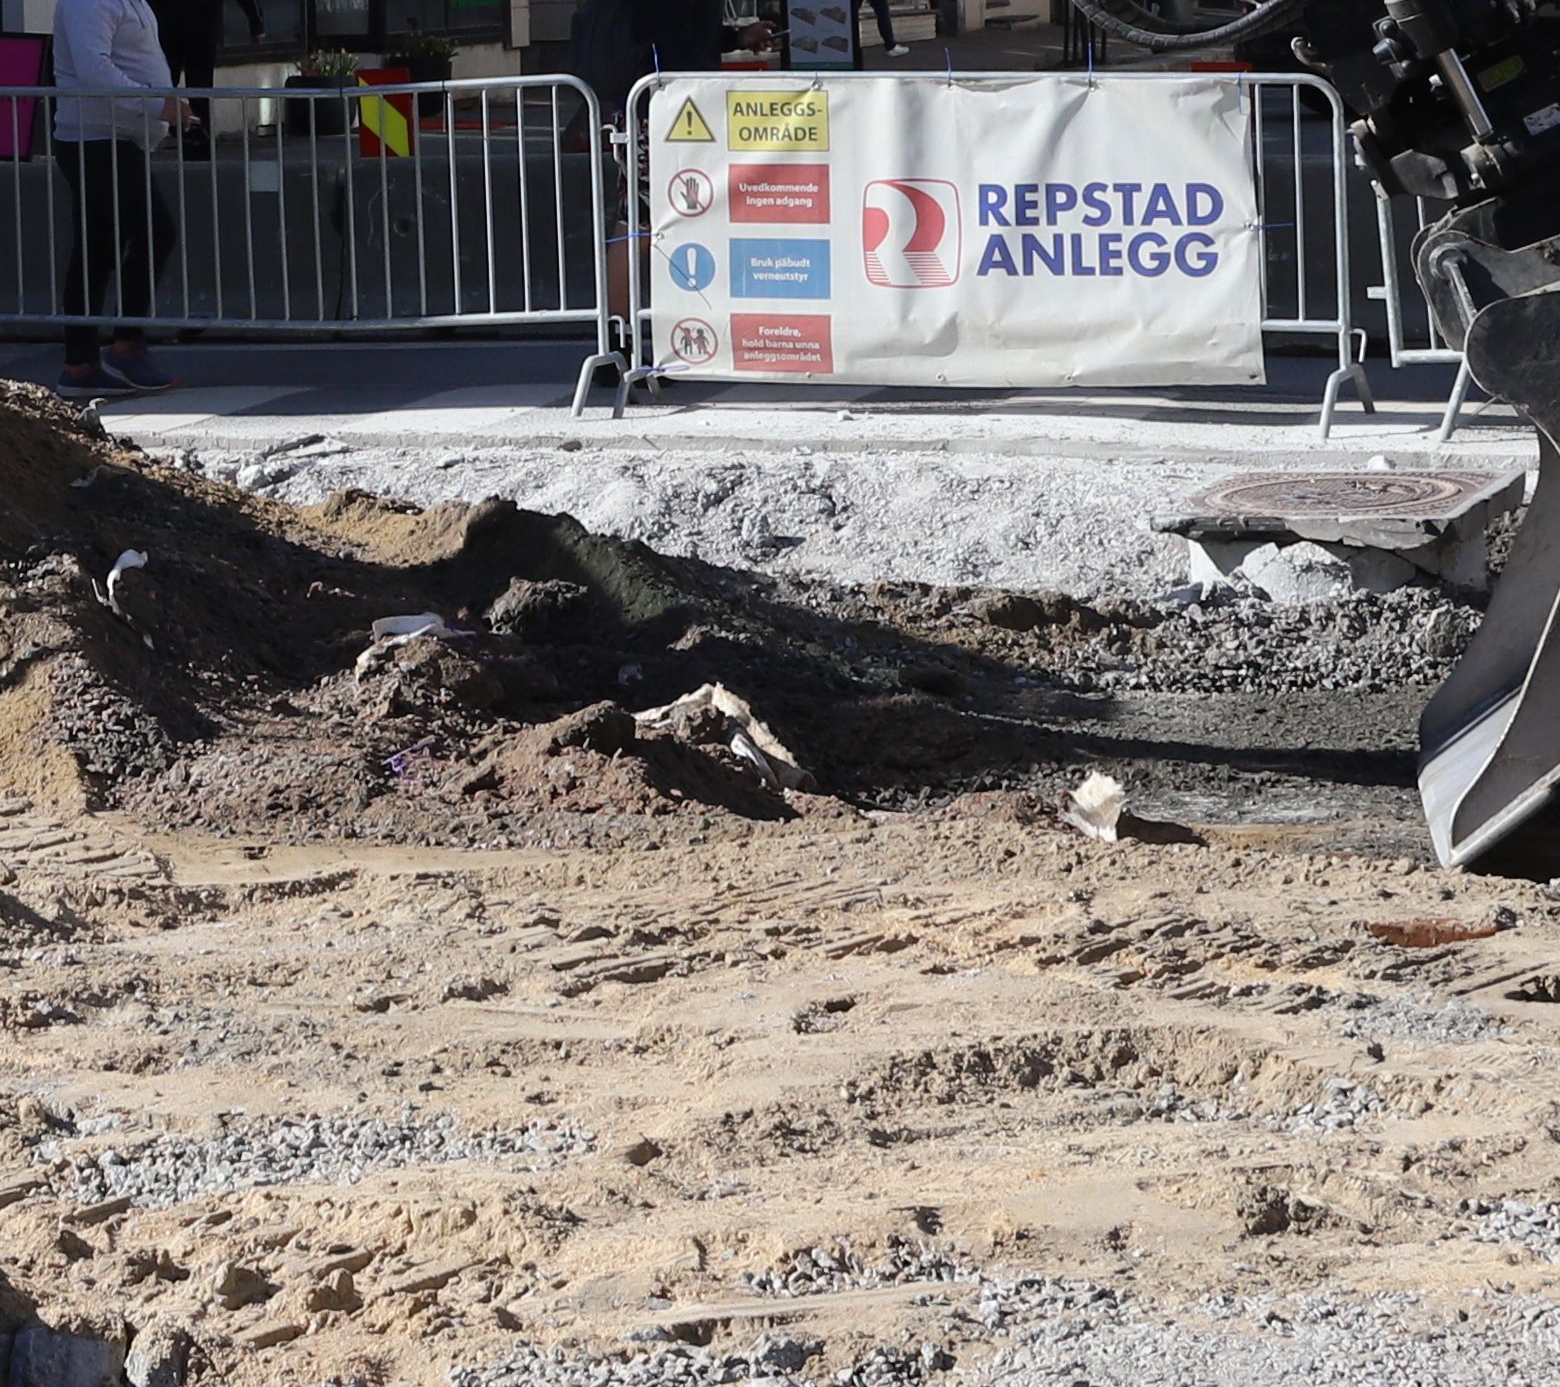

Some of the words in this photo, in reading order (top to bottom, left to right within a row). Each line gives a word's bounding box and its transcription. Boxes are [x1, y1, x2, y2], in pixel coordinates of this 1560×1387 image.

[733, 102, 823, 117] ANLEGGS-
[739, 123, 818, 141] OMRÅDE
[739, 182, 819, 193] Uvedkommende
[775, 195, 812, 207] adgang
[978, 182, 1224, 227] REPSTAD
[976, 232, 1219, 277] ANLEGG
[751, 257, 773, 267] Bruk
[774, 257, 810, 269] påbudt
[753, 272, 808, 283] verneutstyr
[758, 326, 802, 337] Foreldre,
[742, 338, 764, 347] hold
[766, 339, 794, 349] barna
[795, 341, 820, 349] unna
[743, 350, 822, 363] anleggsområdet
